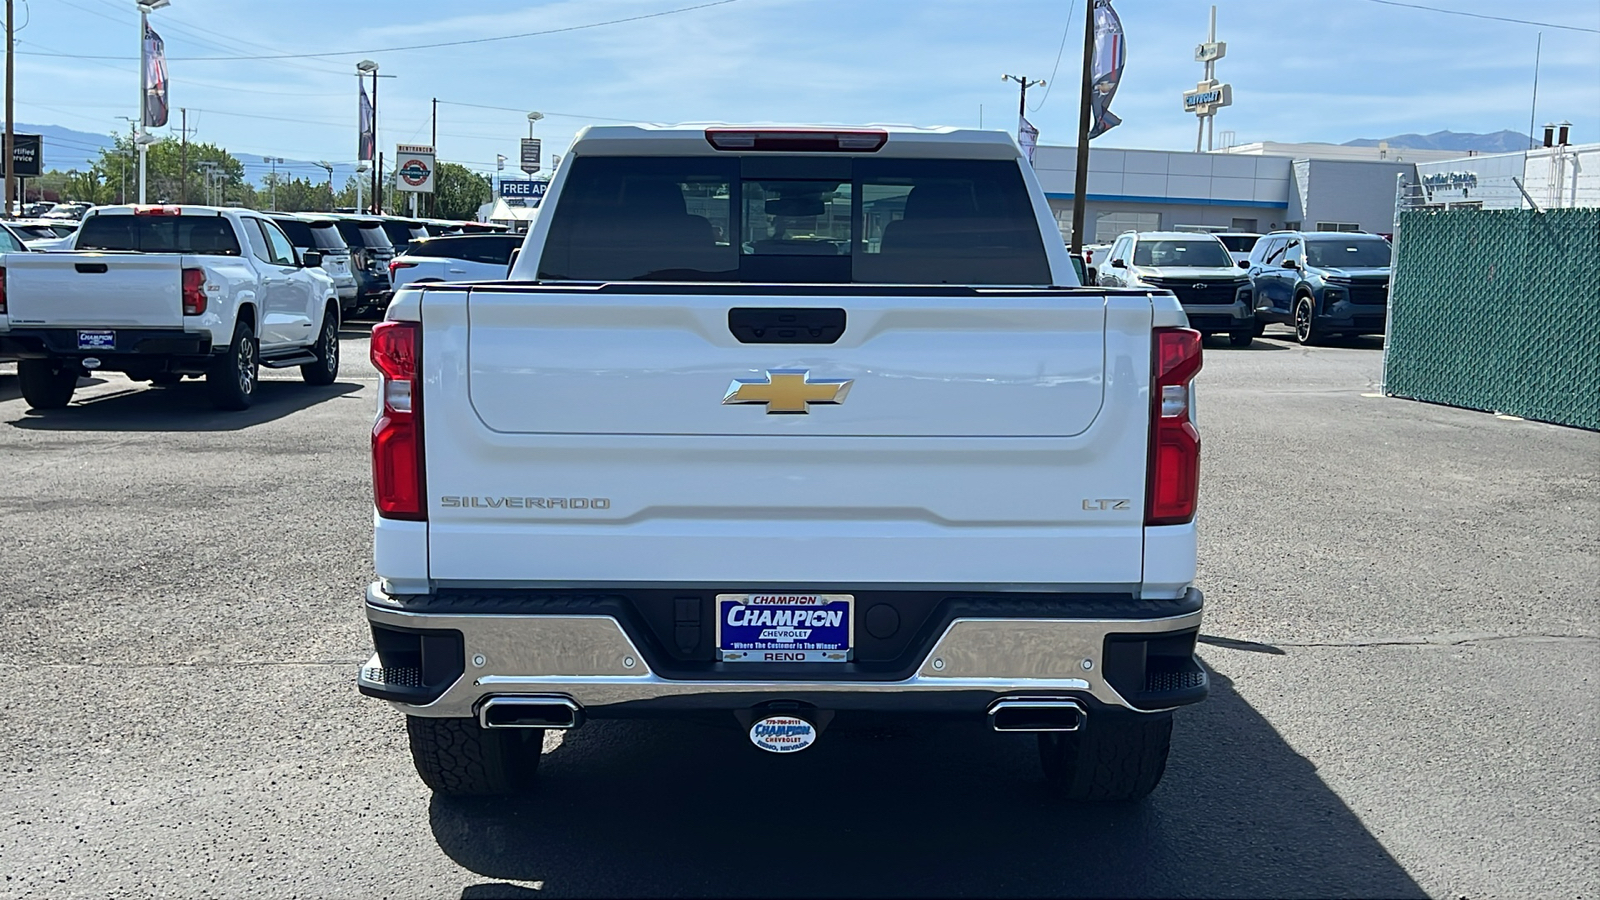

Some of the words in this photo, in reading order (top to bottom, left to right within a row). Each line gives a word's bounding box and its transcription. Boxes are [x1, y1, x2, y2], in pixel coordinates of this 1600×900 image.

[503, 183, 530, 194] FREE
[532, 184, 547, 195] AP
[80, 333, 114, 341] CHAMPION
[441, 496, 611, 509] SILVERADO
[1082, 499, 1131, 511] LTZ
[753, 596, 817, 605] CHAMPION
[727, 605, 844, 628] CHAMPION
[762, 630, 808, 638] CHEVROLET
[804, 642, 815, 650] The
[764, 652, 806, 661] RENO
[755, 724, 811, 737] CHAMPION
[780, 740, 809, 751] NEVADA
